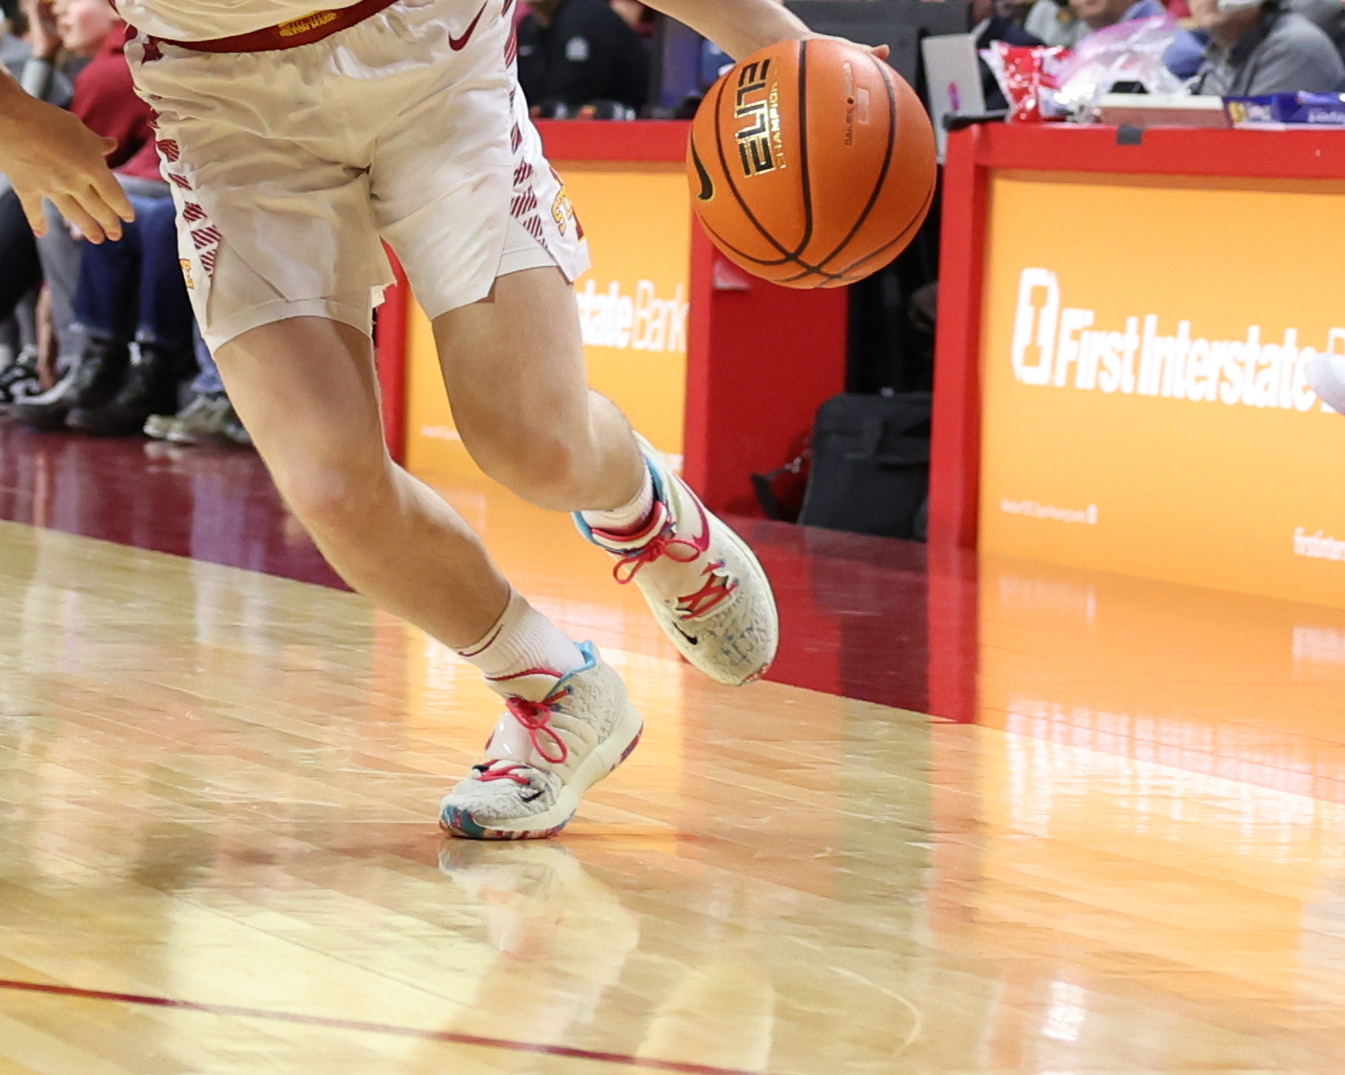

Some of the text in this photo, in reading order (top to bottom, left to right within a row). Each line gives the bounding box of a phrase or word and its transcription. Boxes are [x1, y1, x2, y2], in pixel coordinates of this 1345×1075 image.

[734, 58, 776, 179] ELITE
[631, 279, 690, 354] Bank
[1054, 308, 1140, 394] First
[1137, 313, 1322, 413] Interstate
